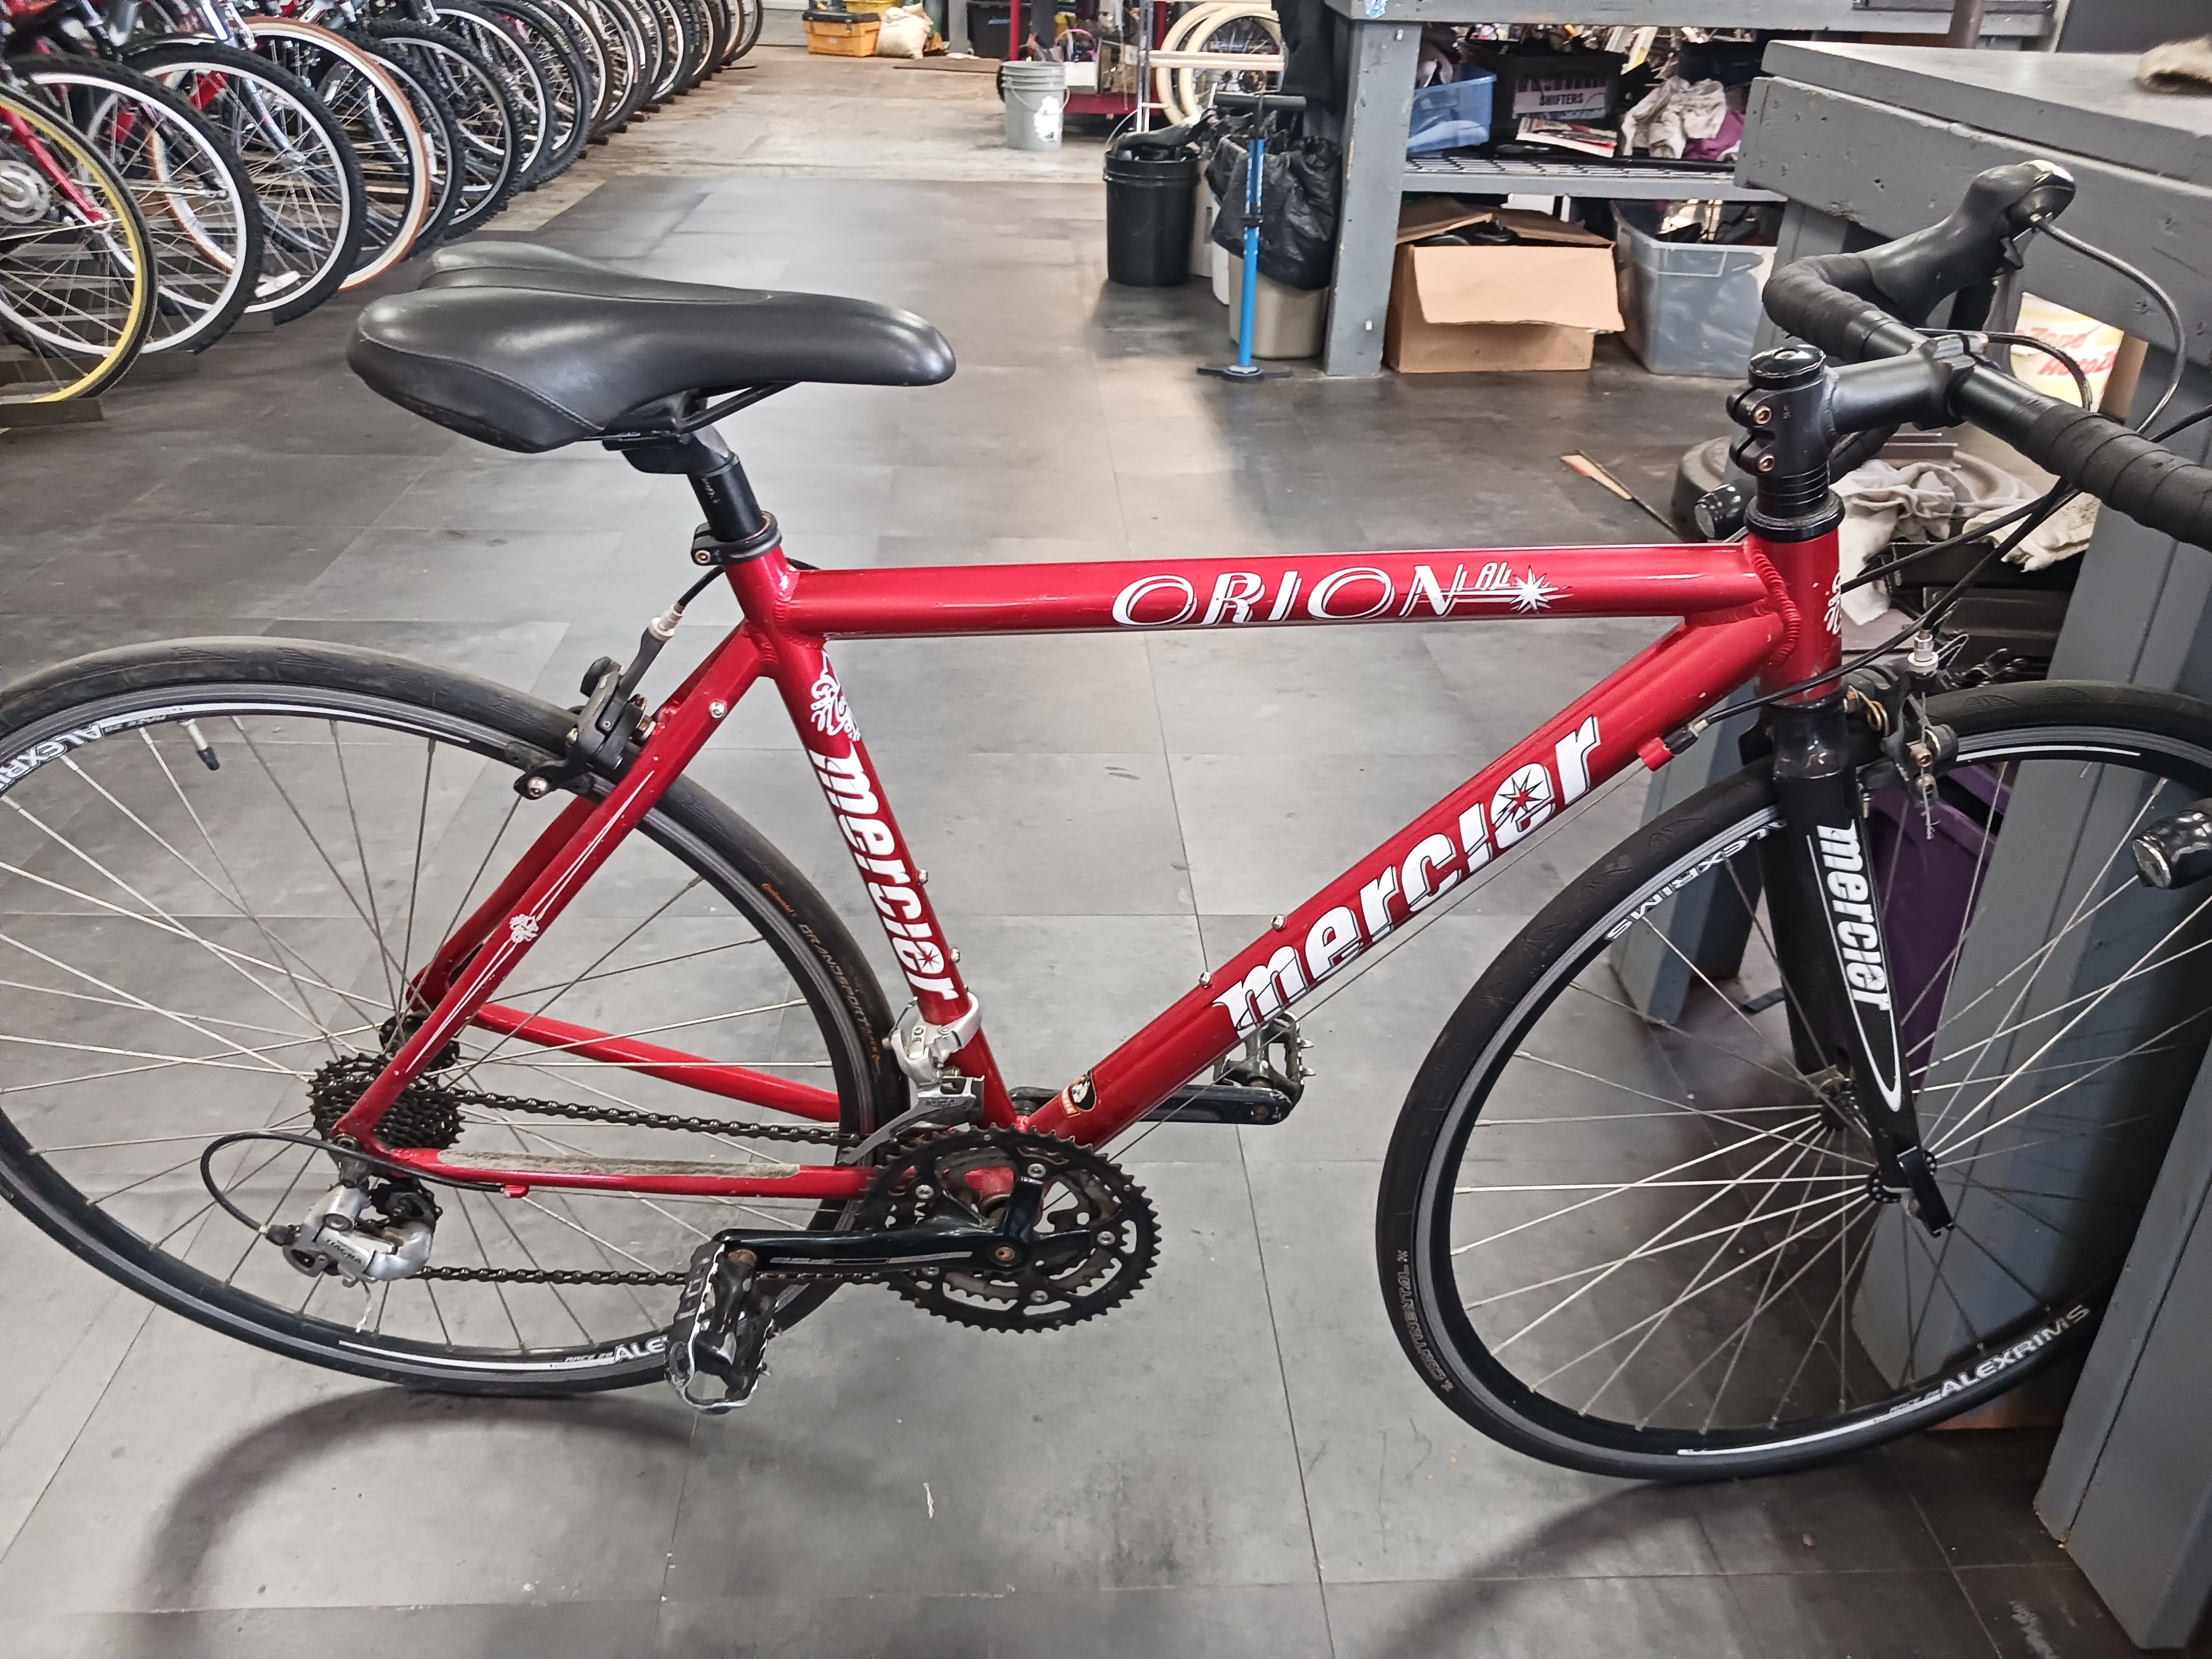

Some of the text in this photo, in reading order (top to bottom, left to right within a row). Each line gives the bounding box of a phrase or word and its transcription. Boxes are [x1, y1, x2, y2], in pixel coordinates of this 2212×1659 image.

[1539, 92, 1584, 106] SHIFTERS
[1111, 562, 1468, 627] ORION
[0, 722, 104, 792] ALEXRI
[808, 742, 960, 1000] mercier
[1212, 714, 1601, 1040] mercier
[1817, 818, 1893, 1011] mercier
[614, 1334, 668, 1363] ALE
[1940, 1303, 2091, 1399] ALEXRIMS
